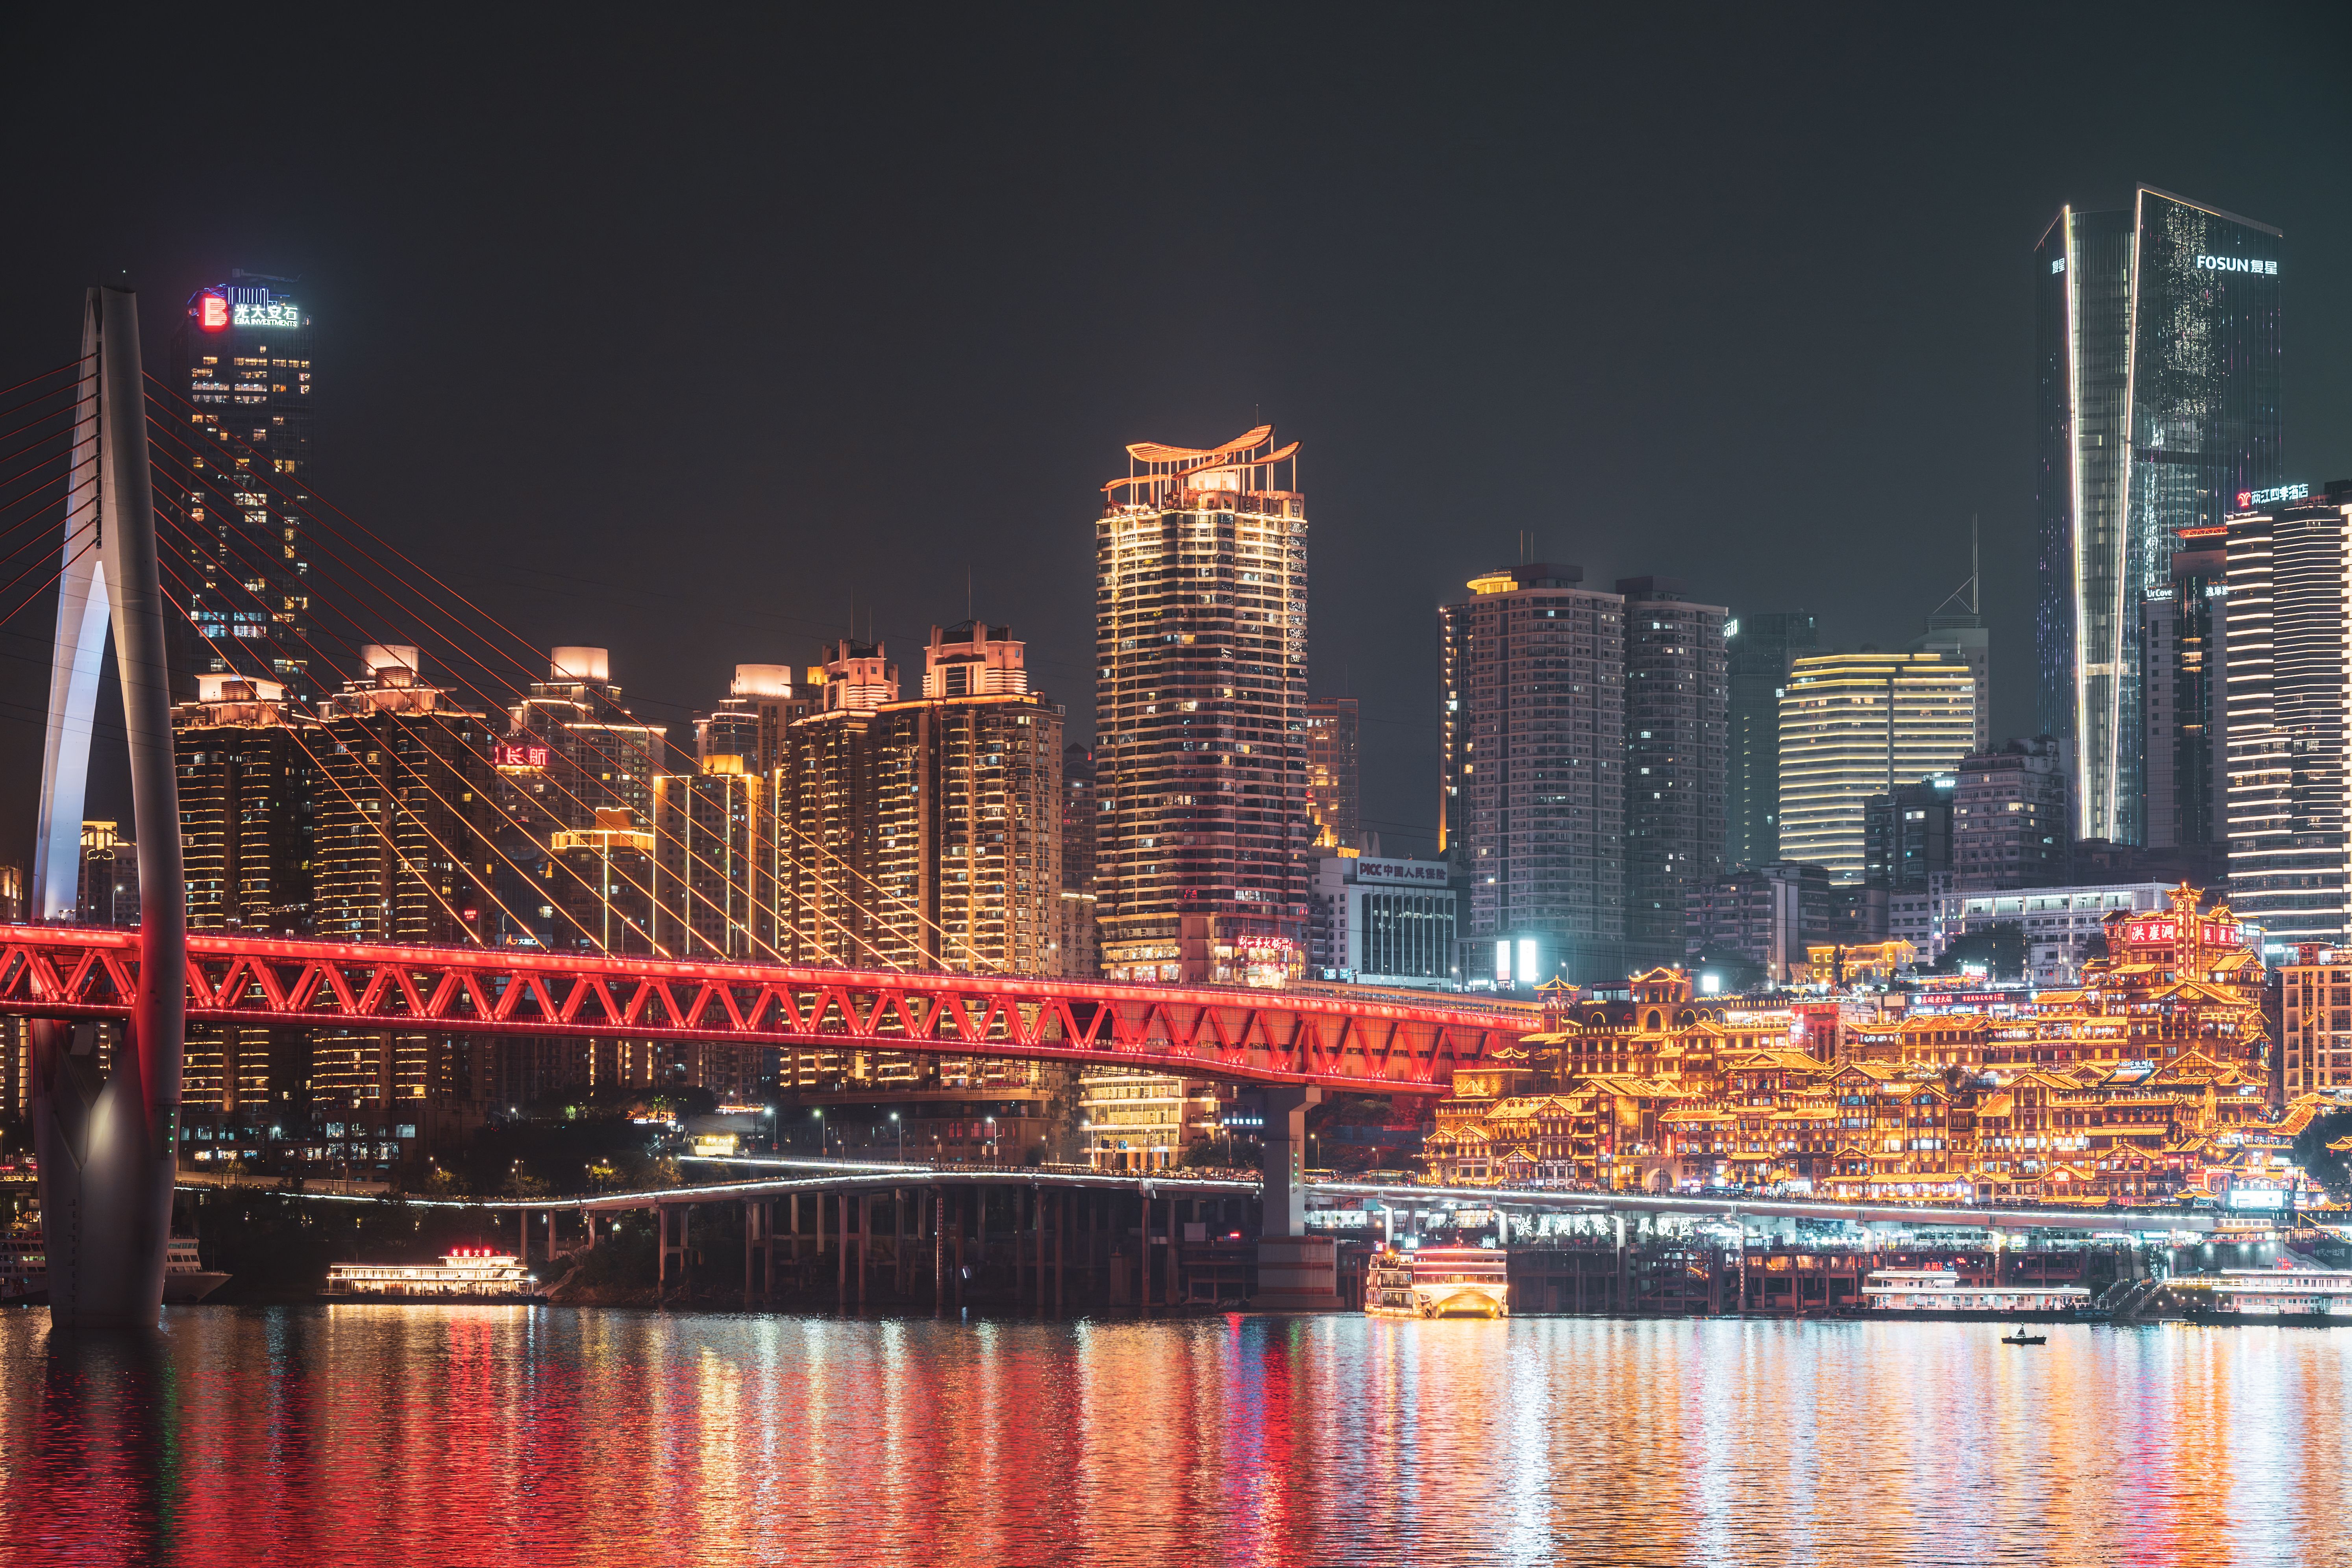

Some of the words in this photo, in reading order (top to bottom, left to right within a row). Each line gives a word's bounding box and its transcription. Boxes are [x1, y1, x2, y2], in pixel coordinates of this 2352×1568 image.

[2052, 258, 2065, 274] 复星
[2197, 255, 2248, 272] FOSUN
[2250, 259, 2278, 275] 复星
[235, 304, 298, 318] 光大安石
[251, 319, 298, 327] INVESTMENTS
[2251, 483, 2309, 504] 两江四季酒店
[2147, 589, 2172, 597] UrCove
[1360, 862, 1382, 876] PICC
[1384, 864, 1446, 880] 中国人民保险
[2132, 924, 2174, 941] 洪崖洞
